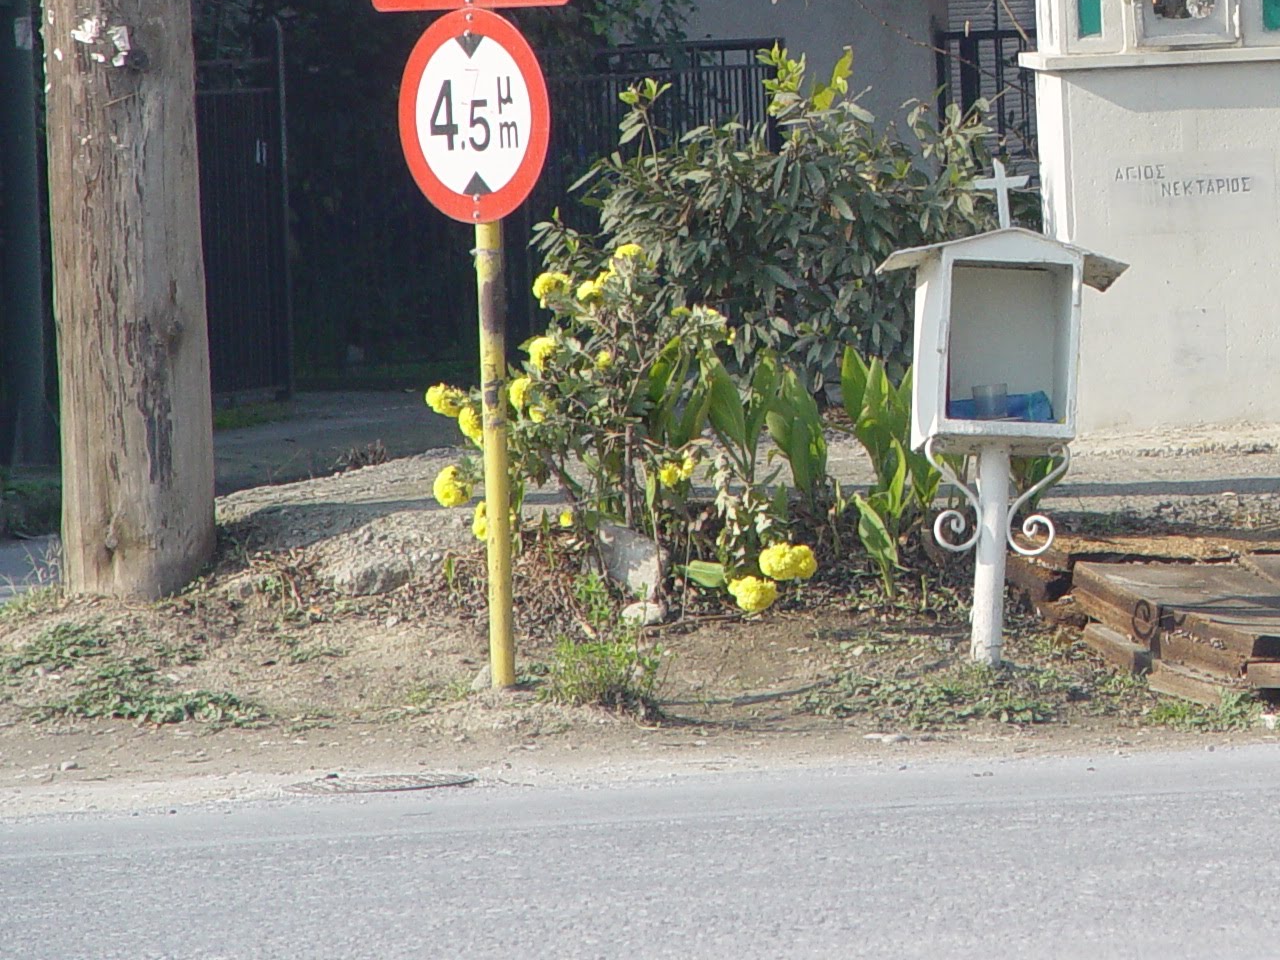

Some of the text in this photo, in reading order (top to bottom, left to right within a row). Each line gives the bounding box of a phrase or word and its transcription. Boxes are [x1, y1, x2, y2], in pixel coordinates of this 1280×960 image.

[430, 79, 491, 152] 4.5
[499, 121, 519, 149] m
[1115, 164, 1166, 182] ΑΓΙΟΣ
[1161, 176, 1251, 197] ΝΕΚΤΑΡΙΟΣ
